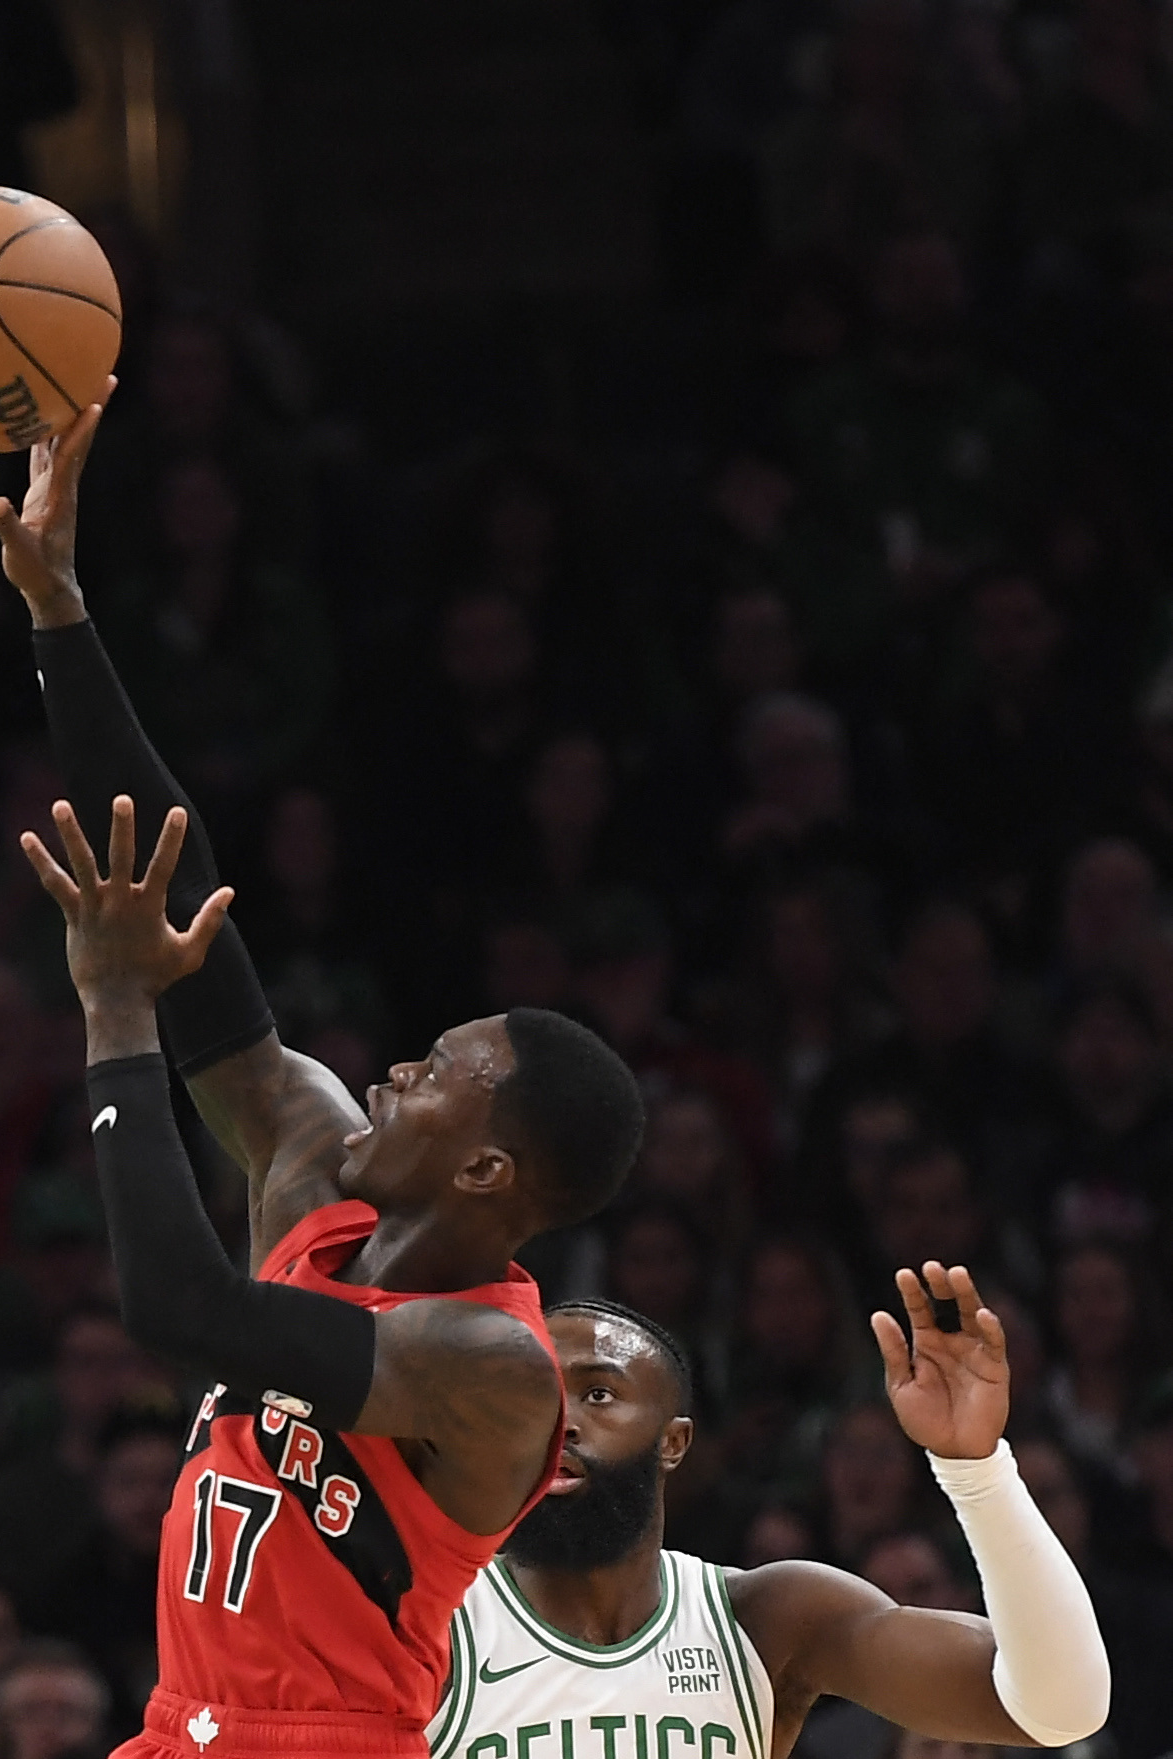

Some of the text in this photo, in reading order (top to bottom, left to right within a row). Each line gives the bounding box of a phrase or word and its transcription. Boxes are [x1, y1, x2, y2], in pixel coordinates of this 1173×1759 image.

[183, 1468, 283, 1615] 17
[661, 1647, 720, 1673] VISTA
[668, 1673, 721, 1694] PRINT
